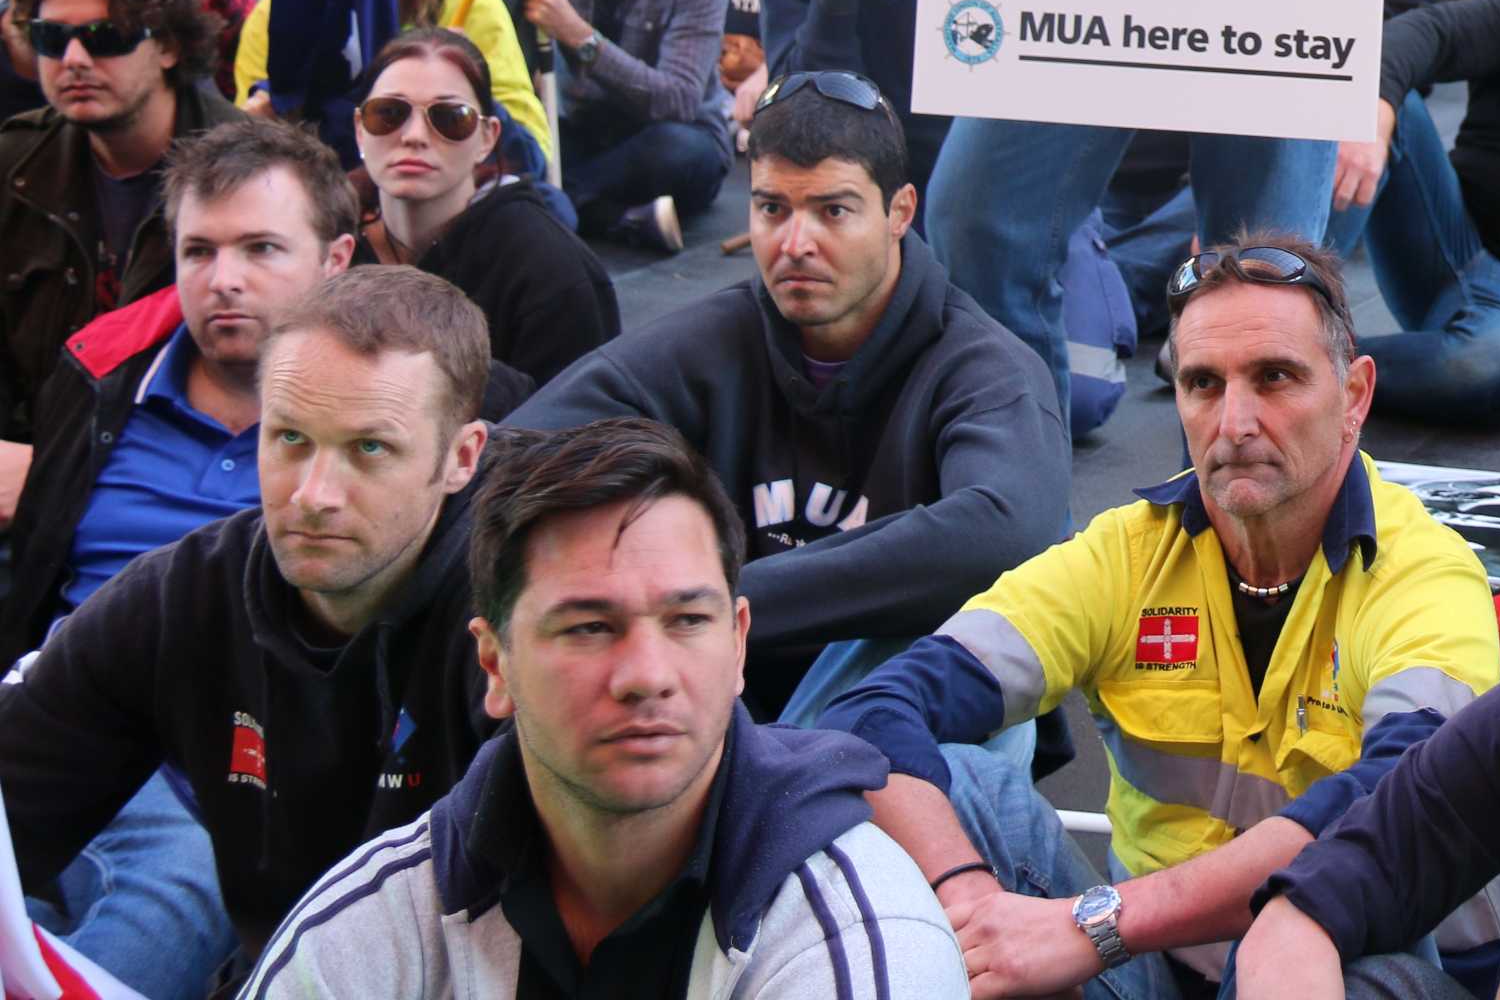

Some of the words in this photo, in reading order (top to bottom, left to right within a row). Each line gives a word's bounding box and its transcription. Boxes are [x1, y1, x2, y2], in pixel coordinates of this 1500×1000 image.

[1019, 11, 1111, 47] MUA
[1122, 14, 1209, 54] here
[1221, 25, 1262, 56] to
[1274, 29, 1356, 69] stay
[1141, 606, 1198, 617] SOLIDARITY
[1146, 662, 1197, 672] STRENGTH
